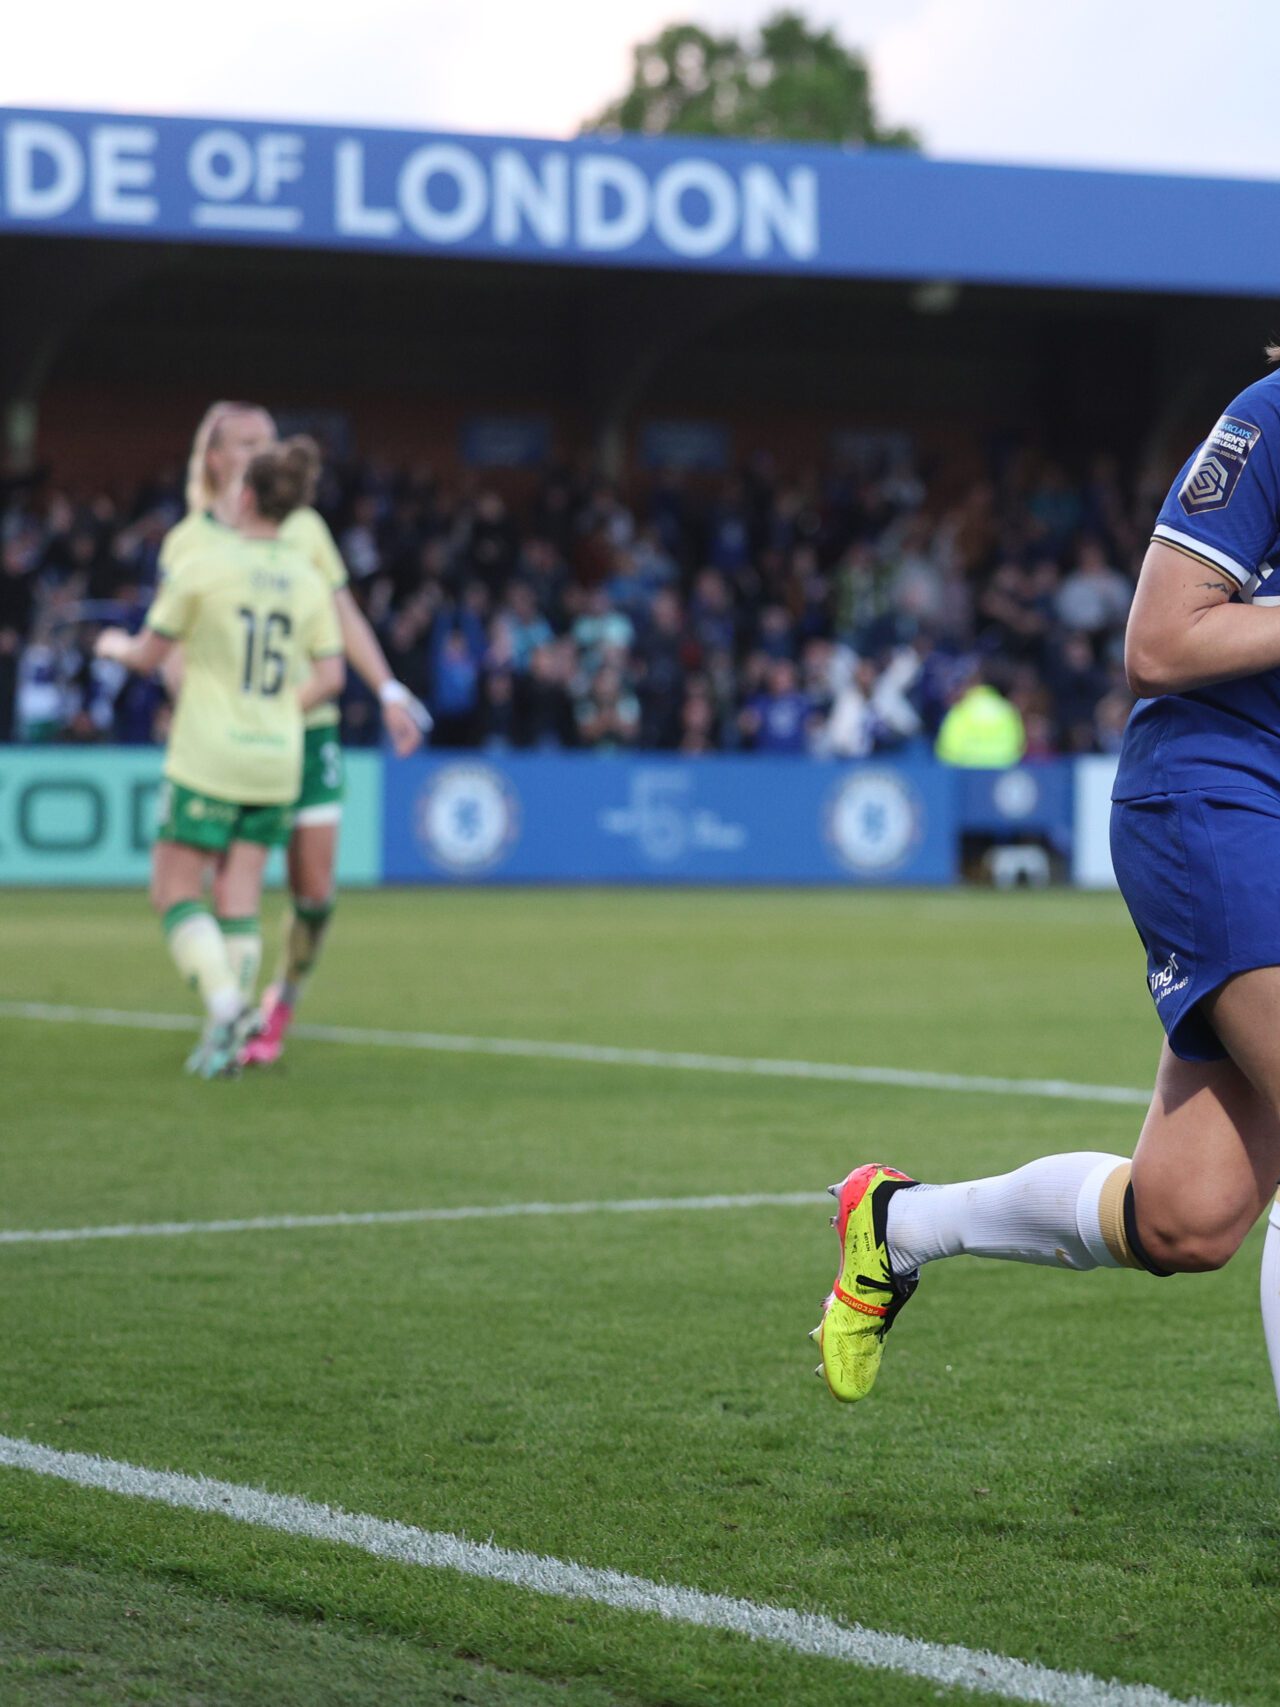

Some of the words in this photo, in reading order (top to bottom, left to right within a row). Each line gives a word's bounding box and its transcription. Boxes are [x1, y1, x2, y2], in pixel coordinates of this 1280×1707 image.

[189, 130, 305, 203] OF
[336, 138, 819, 260] LONDON
[1213, 430, 1247, 448] OMEN'S
[237, 605, 292, 698] 16
